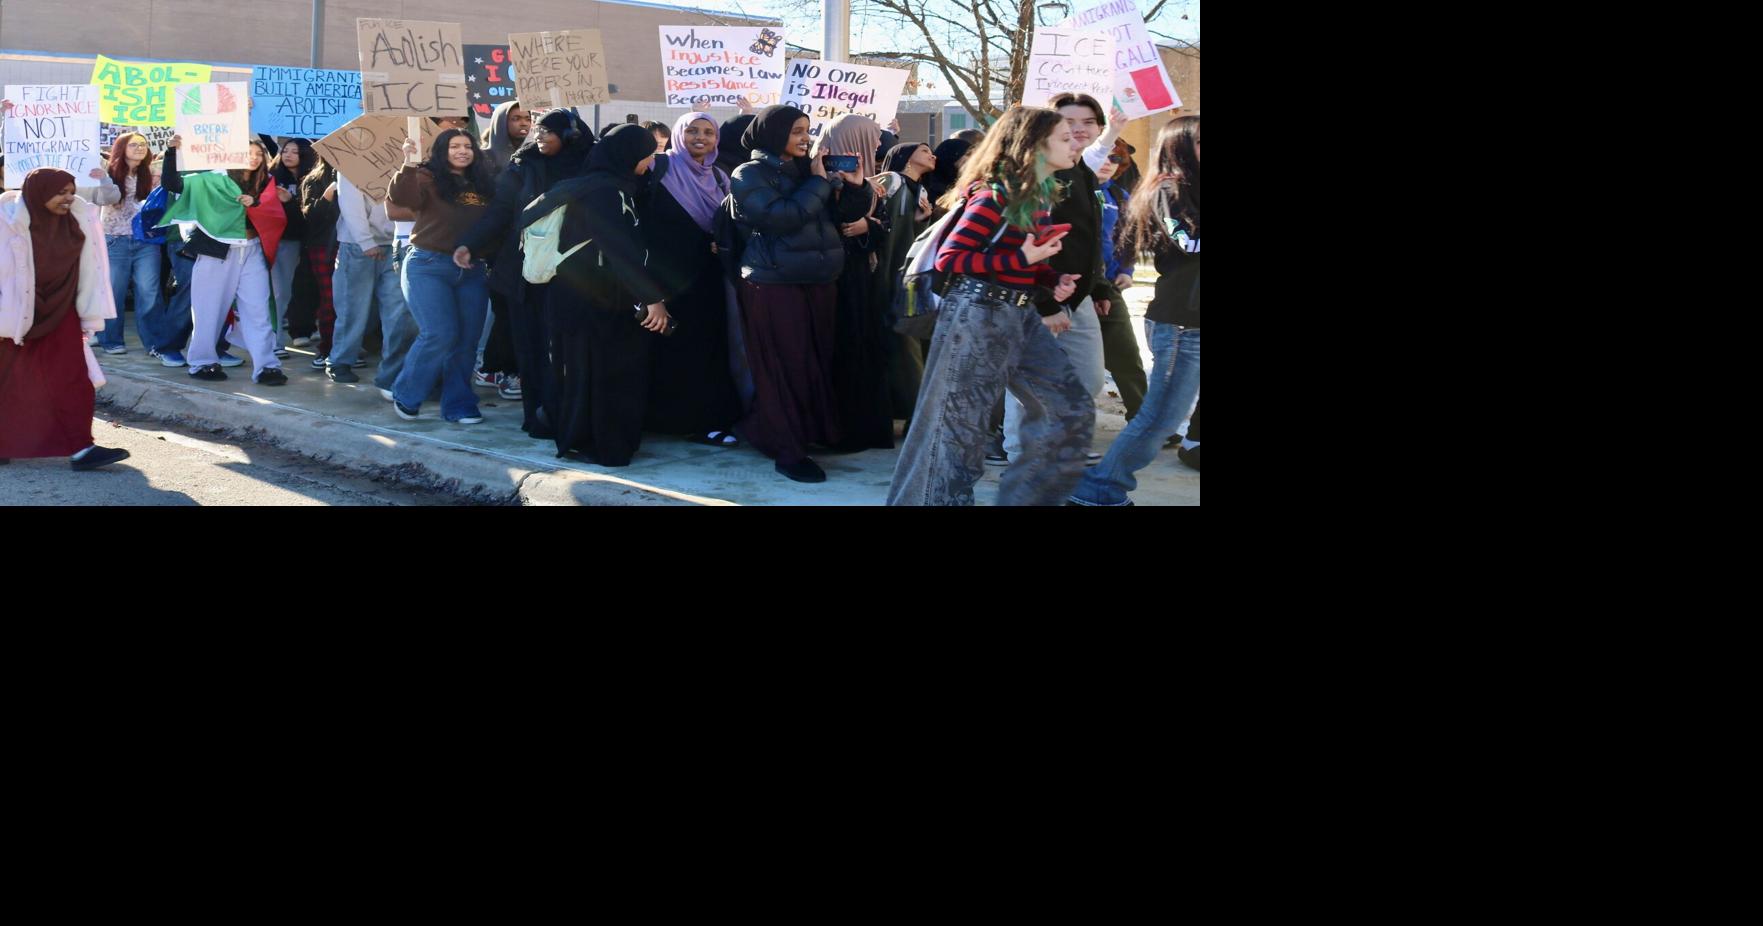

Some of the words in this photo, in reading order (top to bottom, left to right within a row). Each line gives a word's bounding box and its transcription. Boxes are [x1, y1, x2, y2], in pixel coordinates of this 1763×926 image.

[512, 35, 584, 59] WHERE
[665, 28, 724, 49] When
[1034, 33, 1106, 57] ICE
[514, 57, 562, 74] WERE
[566, 52, 602, 72] YOUR
[667, 65, 744, 77] Becomes
[749, 67, 782, 79] Law
[519, 74, 571, 93] PAPERS
[577, 72, 592, 86] IN
[667, 77, 759, 91] Resistance
[828, 68, 868, 84] One
[22, 86, 84, 101] FIGHT
[103, 83, 167, 107] ISH
[254, 80, 302, 97] BUILT
[305, 83, 362, 98] AMERICA
[372, 81, 458, 112] ICE
[488, 86, 513, 97] OUT
[811, 83, 875, 109] Illegal
[7, 101, 96, 118] IGNORANCE
[111, 103, 166, 123] ICE
[275, 97, 346, 115] ABOLISH
[23, 115, 71, 139] NOT
[284, 114, 329, 136] ICE
[6, 138, 90, 154] IMMIGRANTS
[65, 154, 87, 173] ICE
